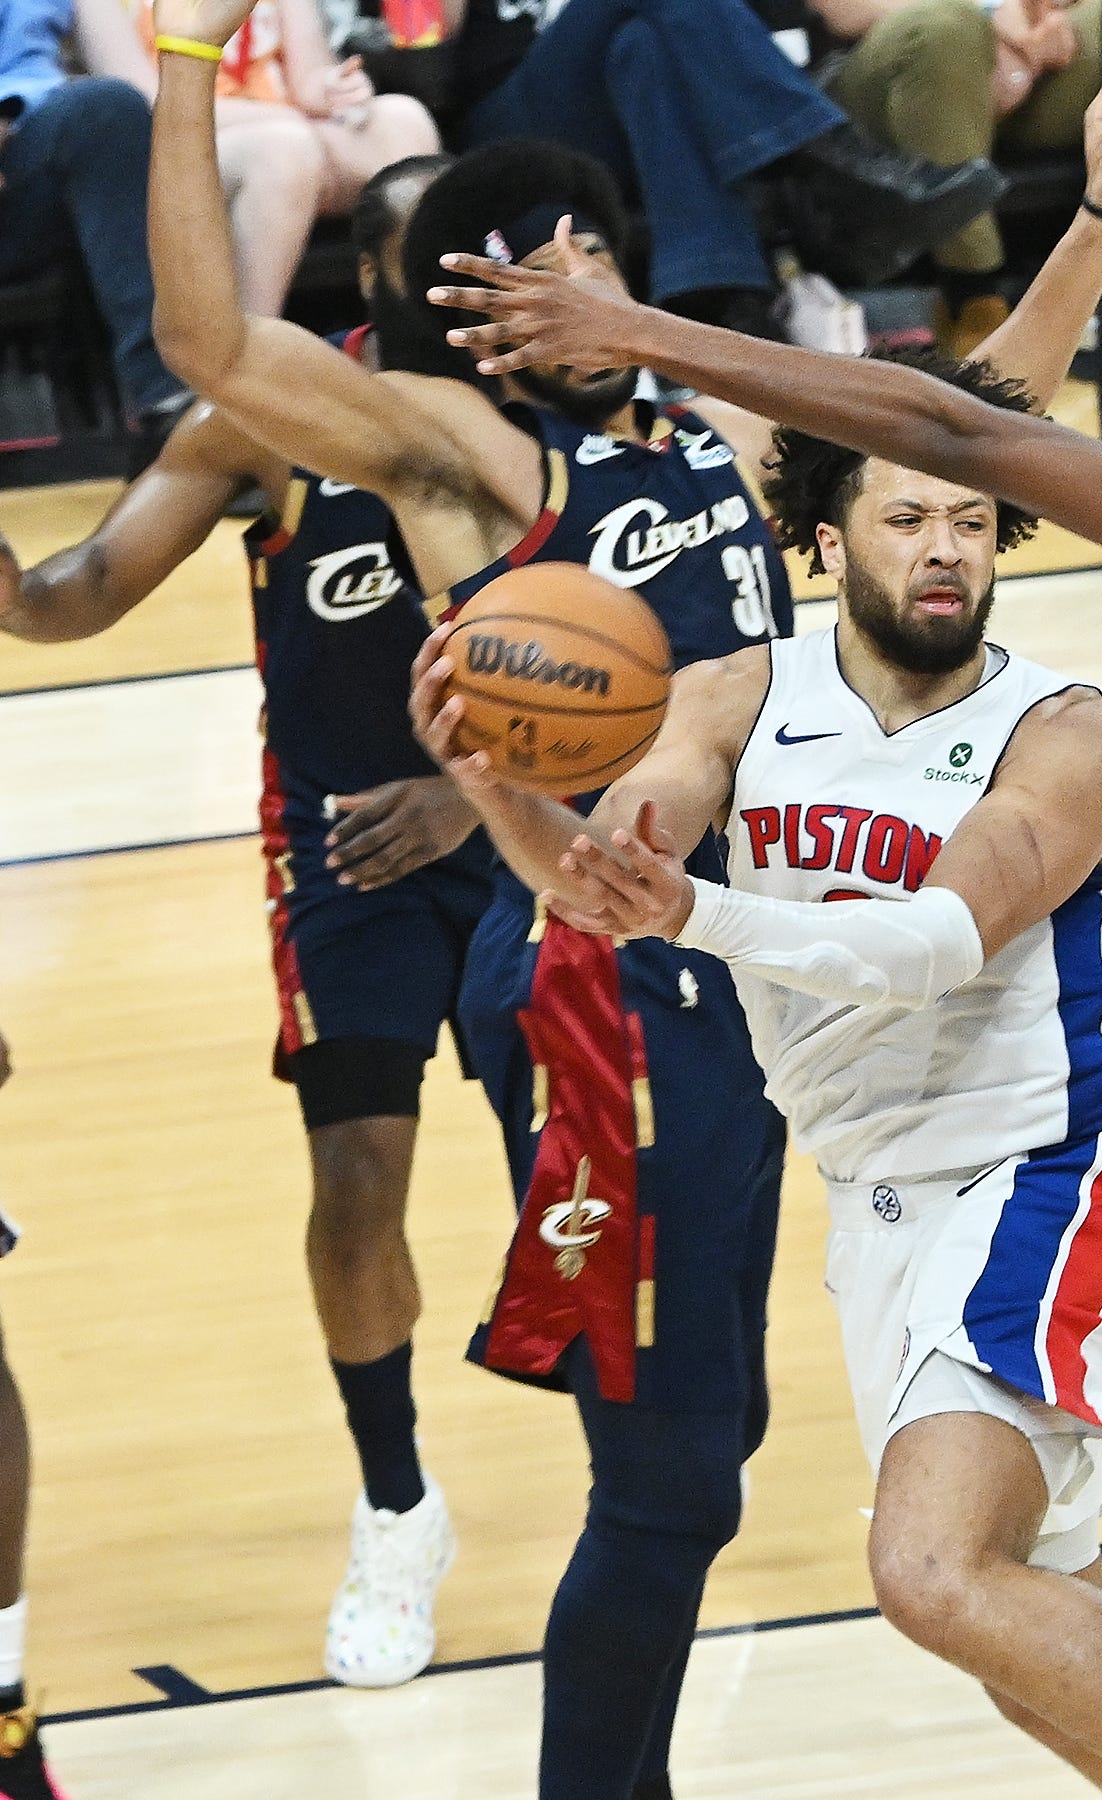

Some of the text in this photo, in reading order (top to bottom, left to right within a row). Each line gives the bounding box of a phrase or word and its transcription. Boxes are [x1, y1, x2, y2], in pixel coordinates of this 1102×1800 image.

[721, 545, 779, 637] 31
[467, 633, 611, 697] Wilson
[923, 767, 985, 787] StockX
[740, 804, 942, 893] PISTON
